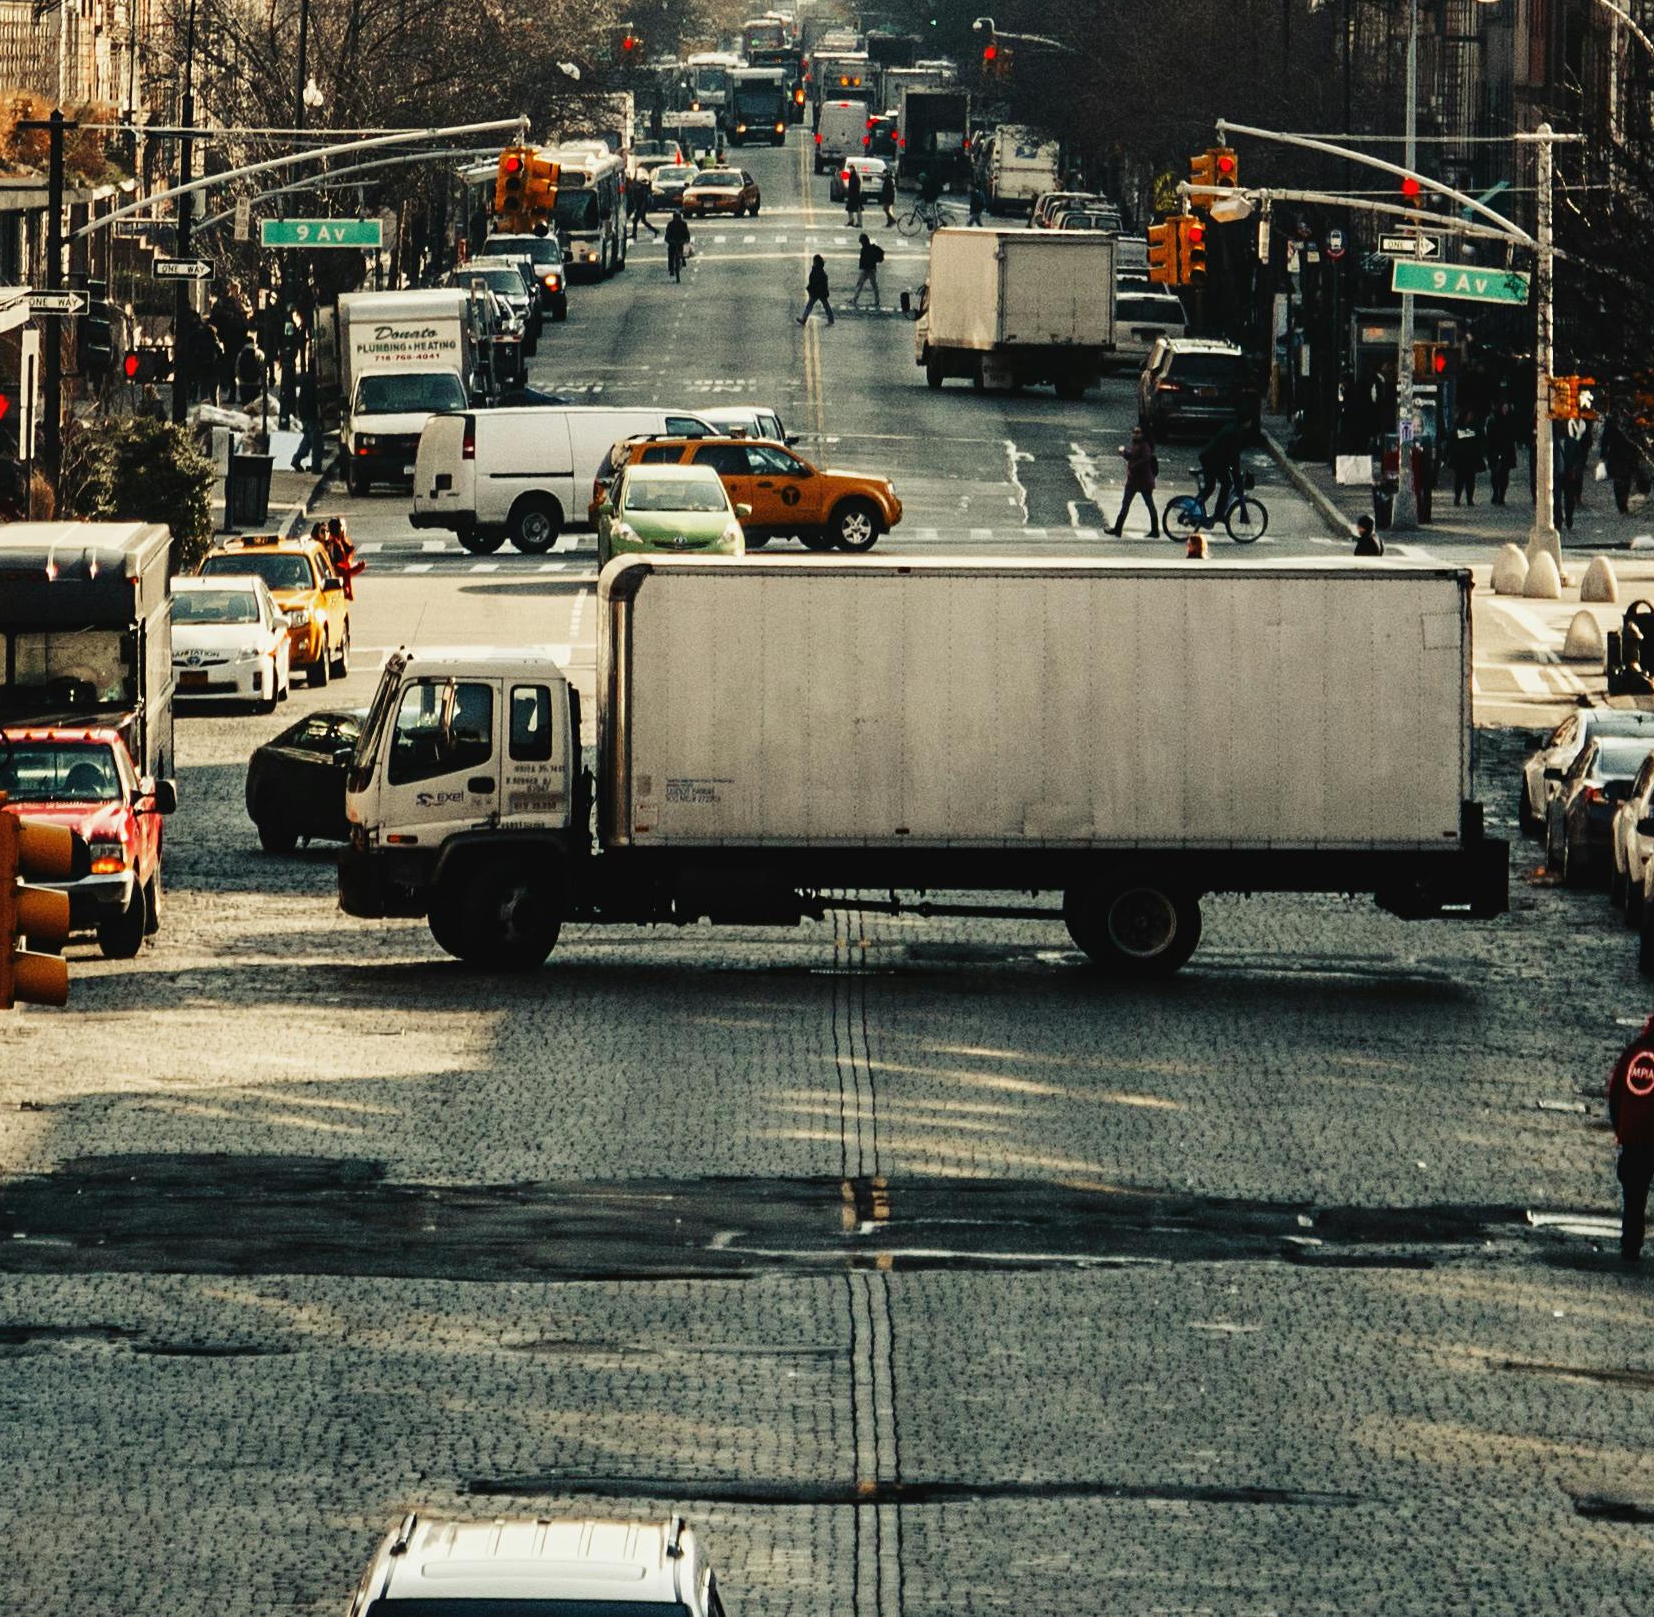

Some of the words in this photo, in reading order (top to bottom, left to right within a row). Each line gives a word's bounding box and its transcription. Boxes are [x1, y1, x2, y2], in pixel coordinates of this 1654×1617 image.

[296, 224, 309, 241] 9
[316, 225, 346, 241] Av
[162, 264, 178, 273] ONE
[187, 265, 205, 273] WAY
[1433, 270, 1447, 289] 9
[1454, 273, 1487, 294] Av
[29, 297, 47, 307] ONE
[57, 296, 78, 307] WAY
[374, 325, 438, 341] Donato
[356, 342, 407, 354] PLUMBING
[413, 340, 457, 352] HEATING
